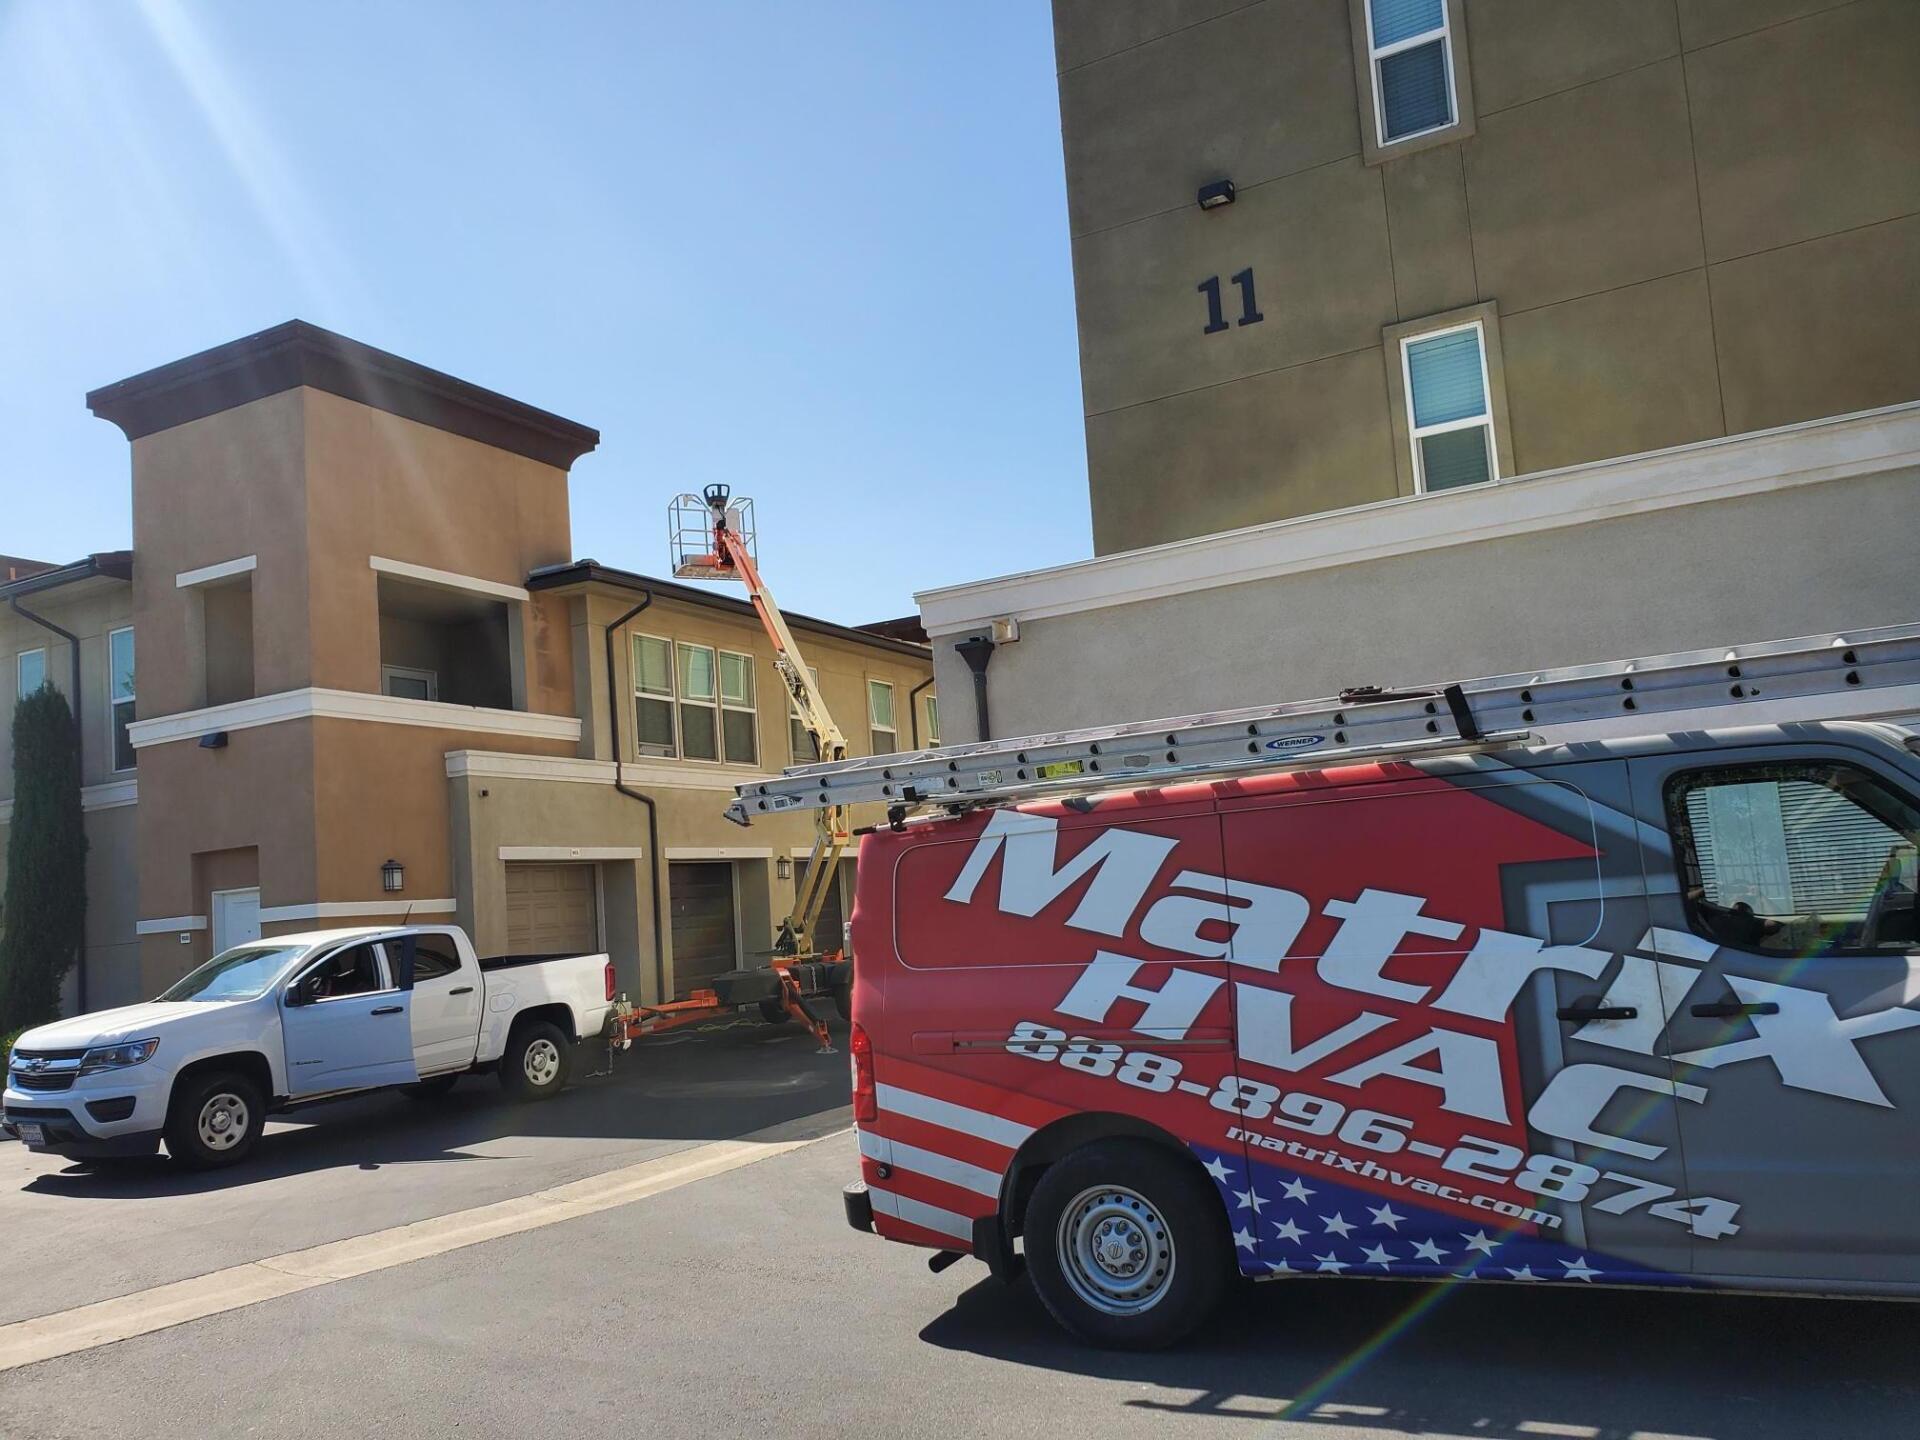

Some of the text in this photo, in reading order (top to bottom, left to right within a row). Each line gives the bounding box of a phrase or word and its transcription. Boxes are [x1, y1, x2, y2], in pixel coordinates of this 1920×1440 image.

[1197, 266, 1264, 335] 11
[1276, 737, 1315, 747] WERNER
[943, 809, 1920, 1109] Matrix
[1004, 1021, 1742, 1241] 888-896-2874
[1053, 949, 1709, 1161] HVAC
[1225, 1126, 1563, 1230] matrixhvac.com
